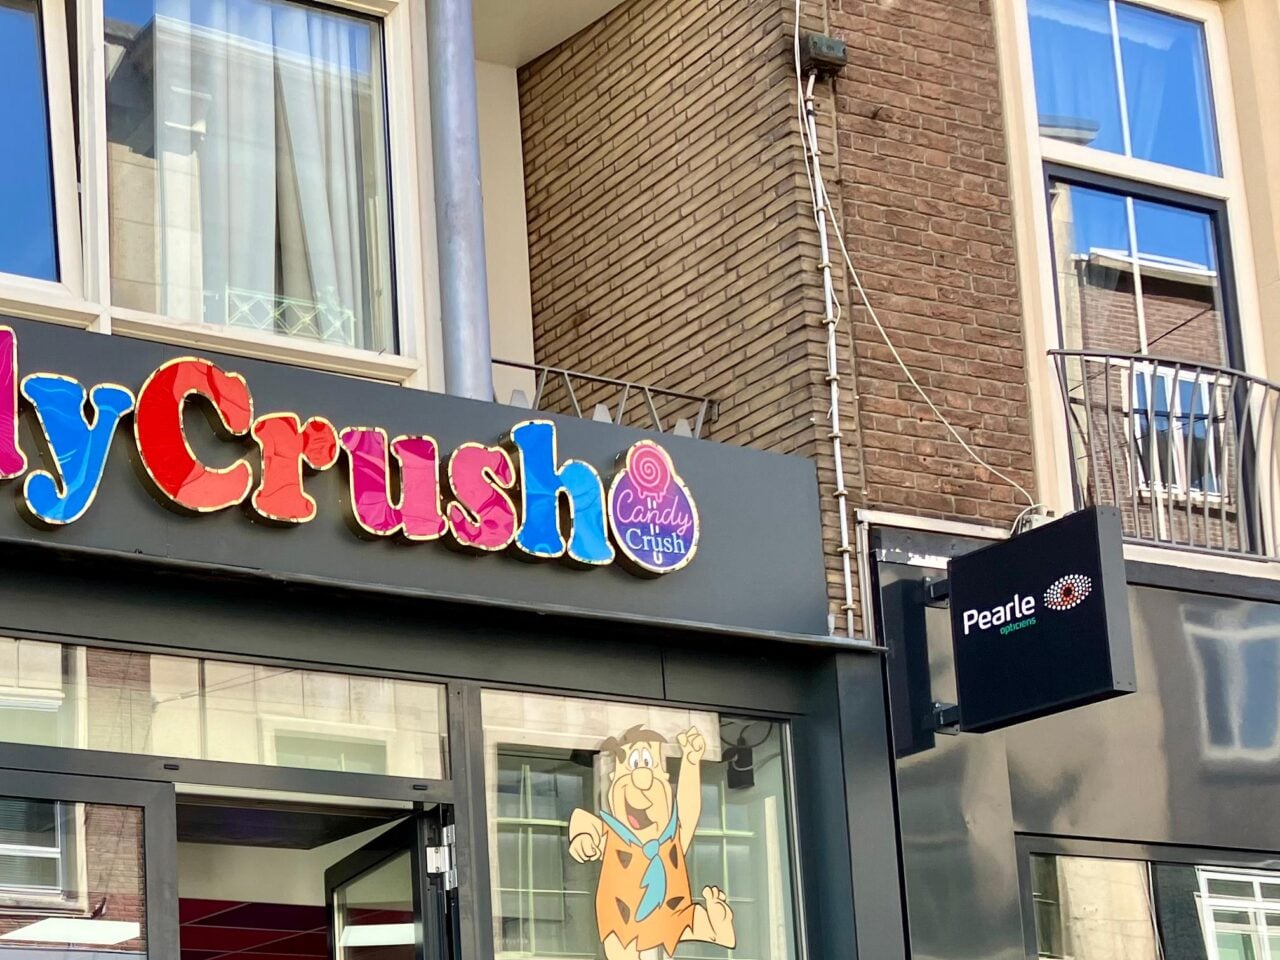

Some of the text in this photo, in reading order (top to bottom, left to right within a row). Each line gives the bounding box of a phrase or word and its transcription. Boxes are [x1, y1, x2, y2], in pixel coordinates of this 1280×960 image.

[616, 489, 693, 536] Candy
[625, 528, 686, 554] Crush
[962, 593, 1036, 636] Pearle
